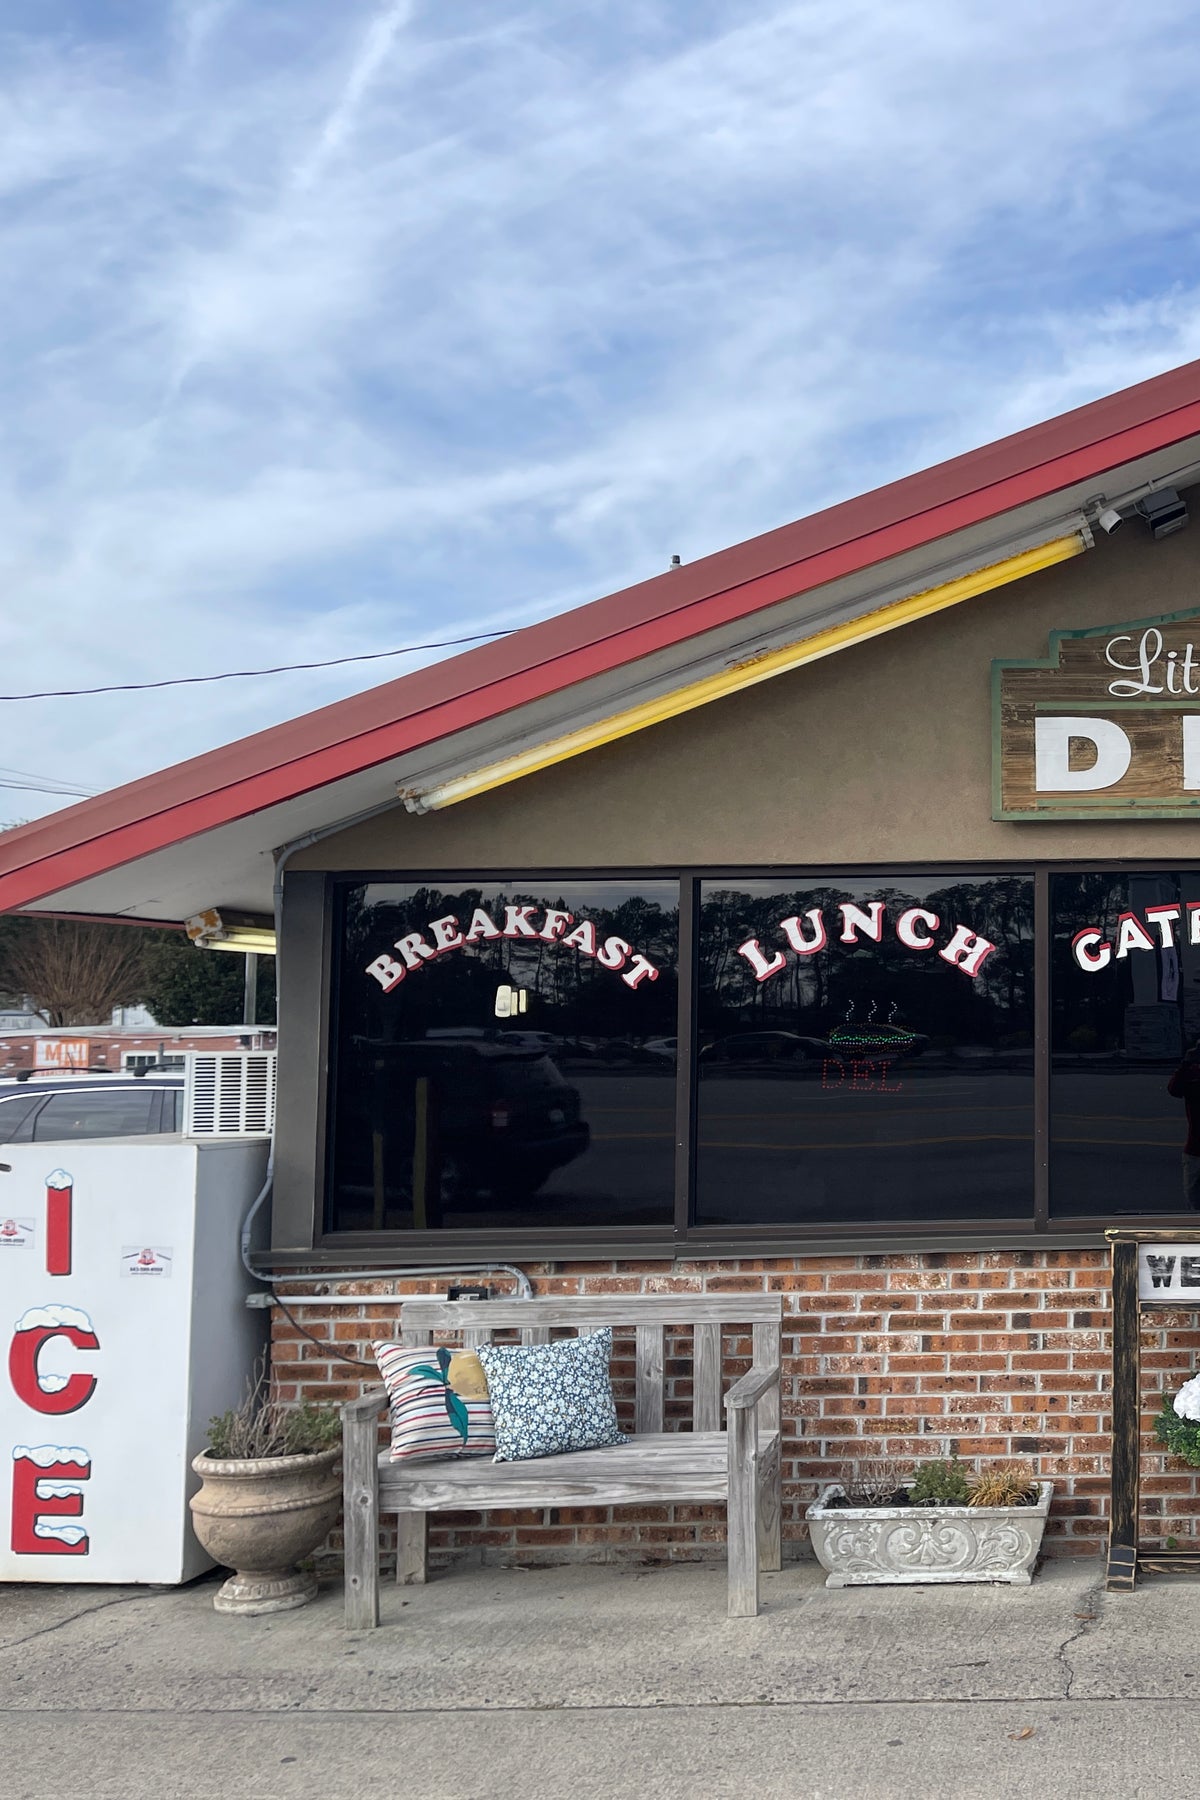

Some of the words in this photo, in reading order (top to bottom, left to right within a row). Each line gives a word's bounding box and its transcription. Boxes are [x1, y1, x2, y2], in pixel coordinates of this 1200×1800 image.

[365, 905, 659, 994] BREAKFAST
[737, 901, 996, 982] LUNCH
[8, 1168, 101, 1555] ICE
